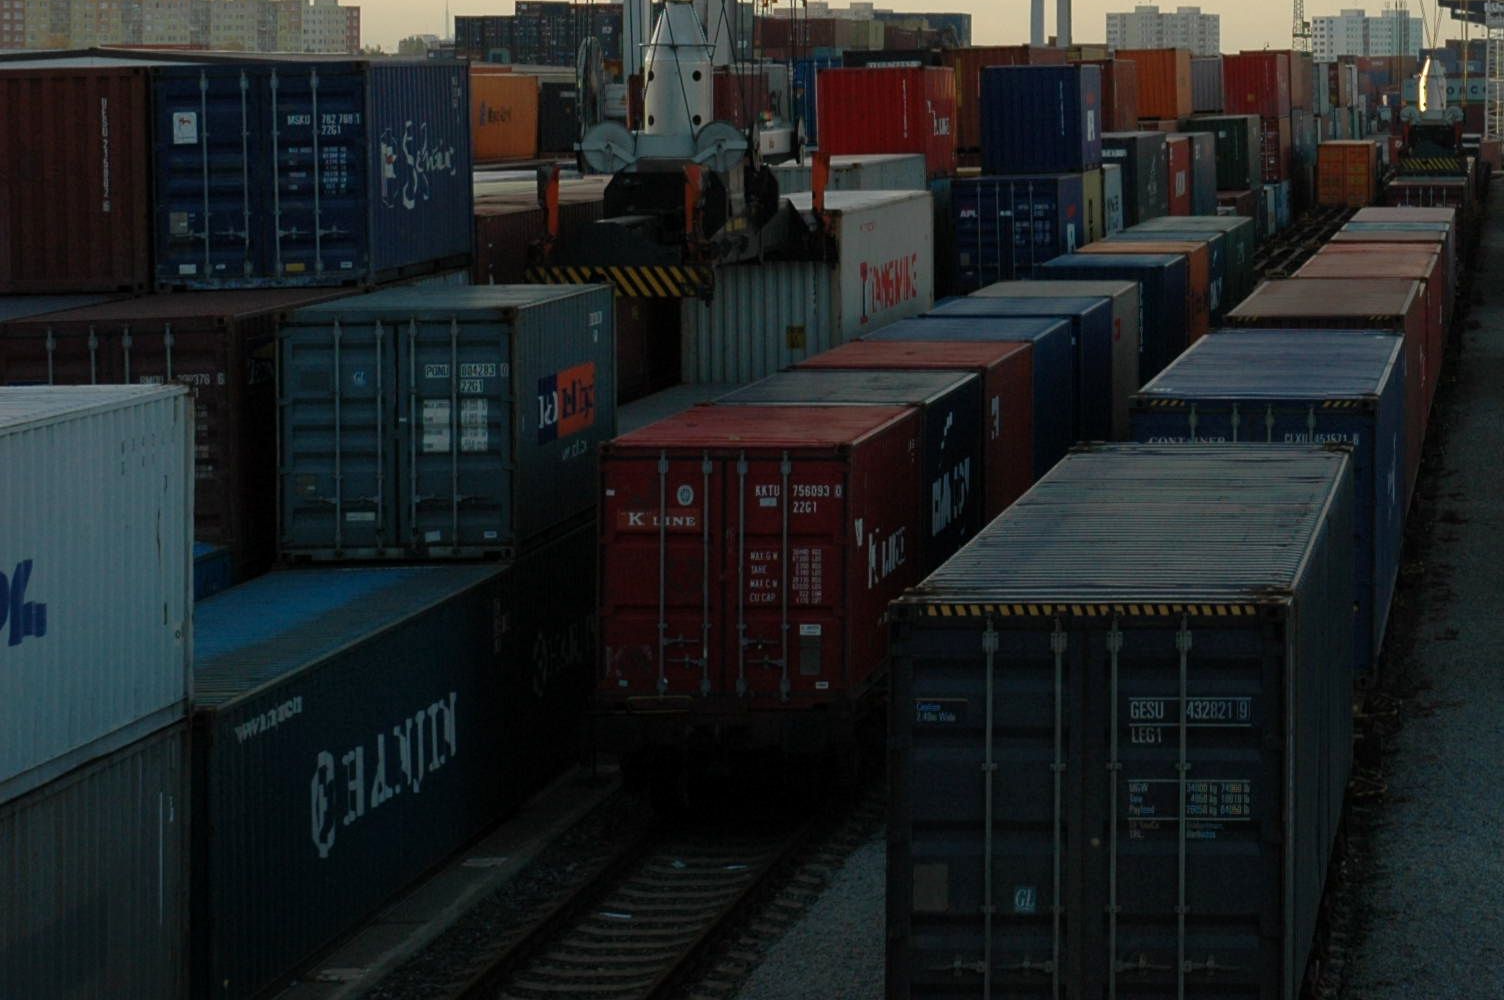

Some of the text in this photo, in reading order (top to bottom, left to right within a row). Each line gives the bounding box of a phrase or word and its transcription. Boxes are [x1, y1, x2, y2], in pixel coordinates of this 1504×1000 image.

[652, 515, 696, 527] LINE
[1130, 701, 1165, 721] GESU
[1186, 701, 1233, 721] 432821
[1131, 727, 1163, 744] LEG1
